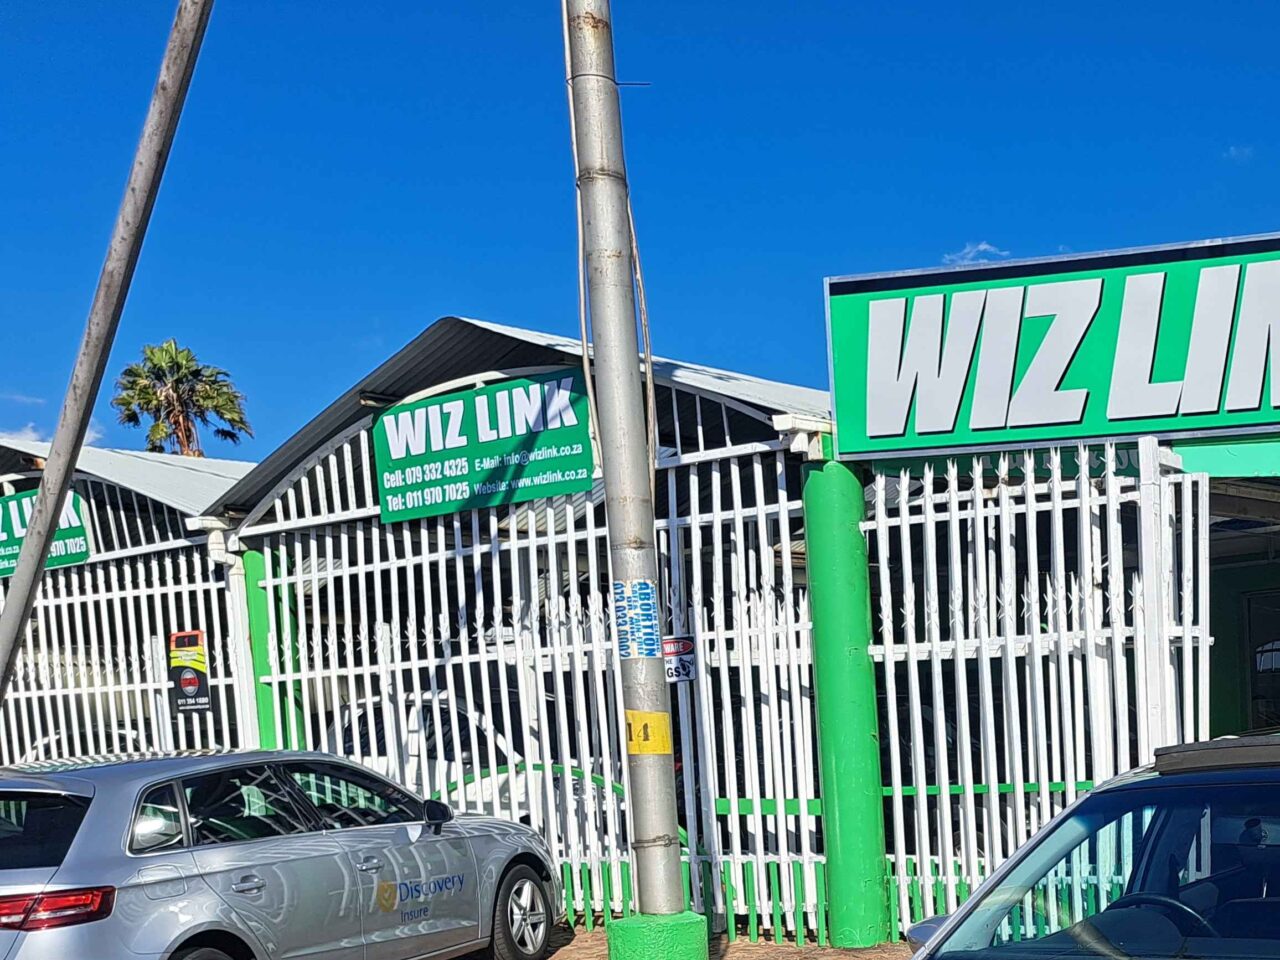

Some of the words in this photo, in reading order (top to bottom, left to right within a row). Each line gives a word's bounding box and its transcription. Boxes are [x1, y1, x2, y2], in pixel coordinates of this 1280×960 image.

[866, 278, 1103, 438] WIZ
[383, 399, 468, 460] WIZ
[474, 376, 578, 443] LINK
[475, 456, 502, 472] E-Mail:
[503, 443, 583, 466] info@wizlink.co.za
[383, 468, 404, 489] Cell:
[405, 464, 423, 485] 079
[424, 461, 442, 482] 332
[443, 457, 469, 478] 4325
[474, 480, 509, 496] Website:
[510, 467, 588, 490] www.wizlink.co.za
[386, 493, 404, 512] Tel:
[406, 490, 423, 508] 011
[424, 487, 442, 505] 970
[444, 482, 470, 502] 7025
[8, 490, 81, 538] LIK
[65, 537, 87, 554] 7025
[637, 581, 656, 657] ABORTION
[399, 872, 465, 902] Discovery
[400, 906, 430, 923] Insure
